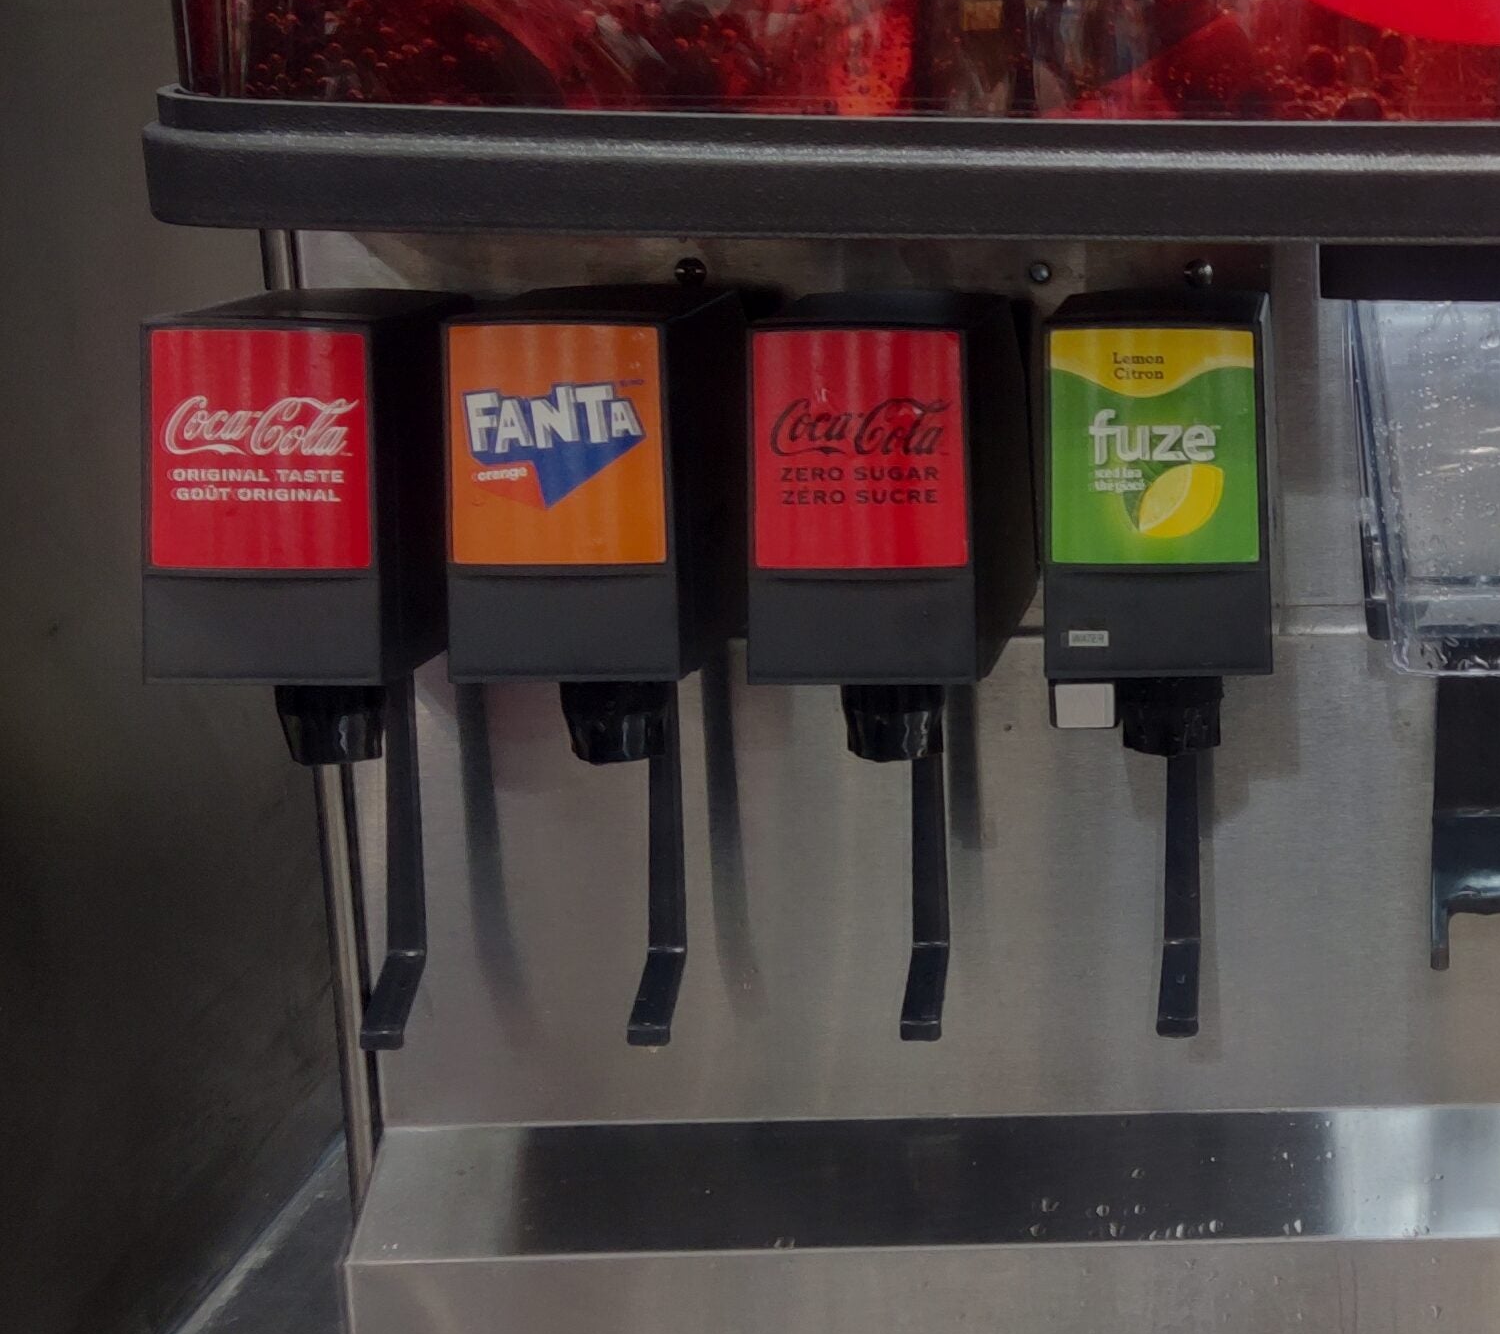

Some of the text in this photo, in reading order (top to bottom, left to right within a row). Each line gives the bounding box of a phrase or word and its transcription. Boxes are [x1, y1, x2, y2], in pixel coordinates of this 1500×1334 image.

[1112, 352, 1165, 365] Lemon
[1113, 367, 1165, 380] Citron
[163, 395, 360, 457] Coca-Cola
[463, 384, 645, 454] FANTA
[770, 397, 952, 457] Coca-Cola
[1088, 408, 1217, 465] fuze
[170, 468, 345, 483] ORIGINAL TASTE
[476, 467, 528, 482] orange
[781, 467, 940, 482] ZERO SUGAR
[174, 484, 342, 503] GOÛT ORIGINAL
[782, 486, 939, 505] ZÉRO SUCRE
